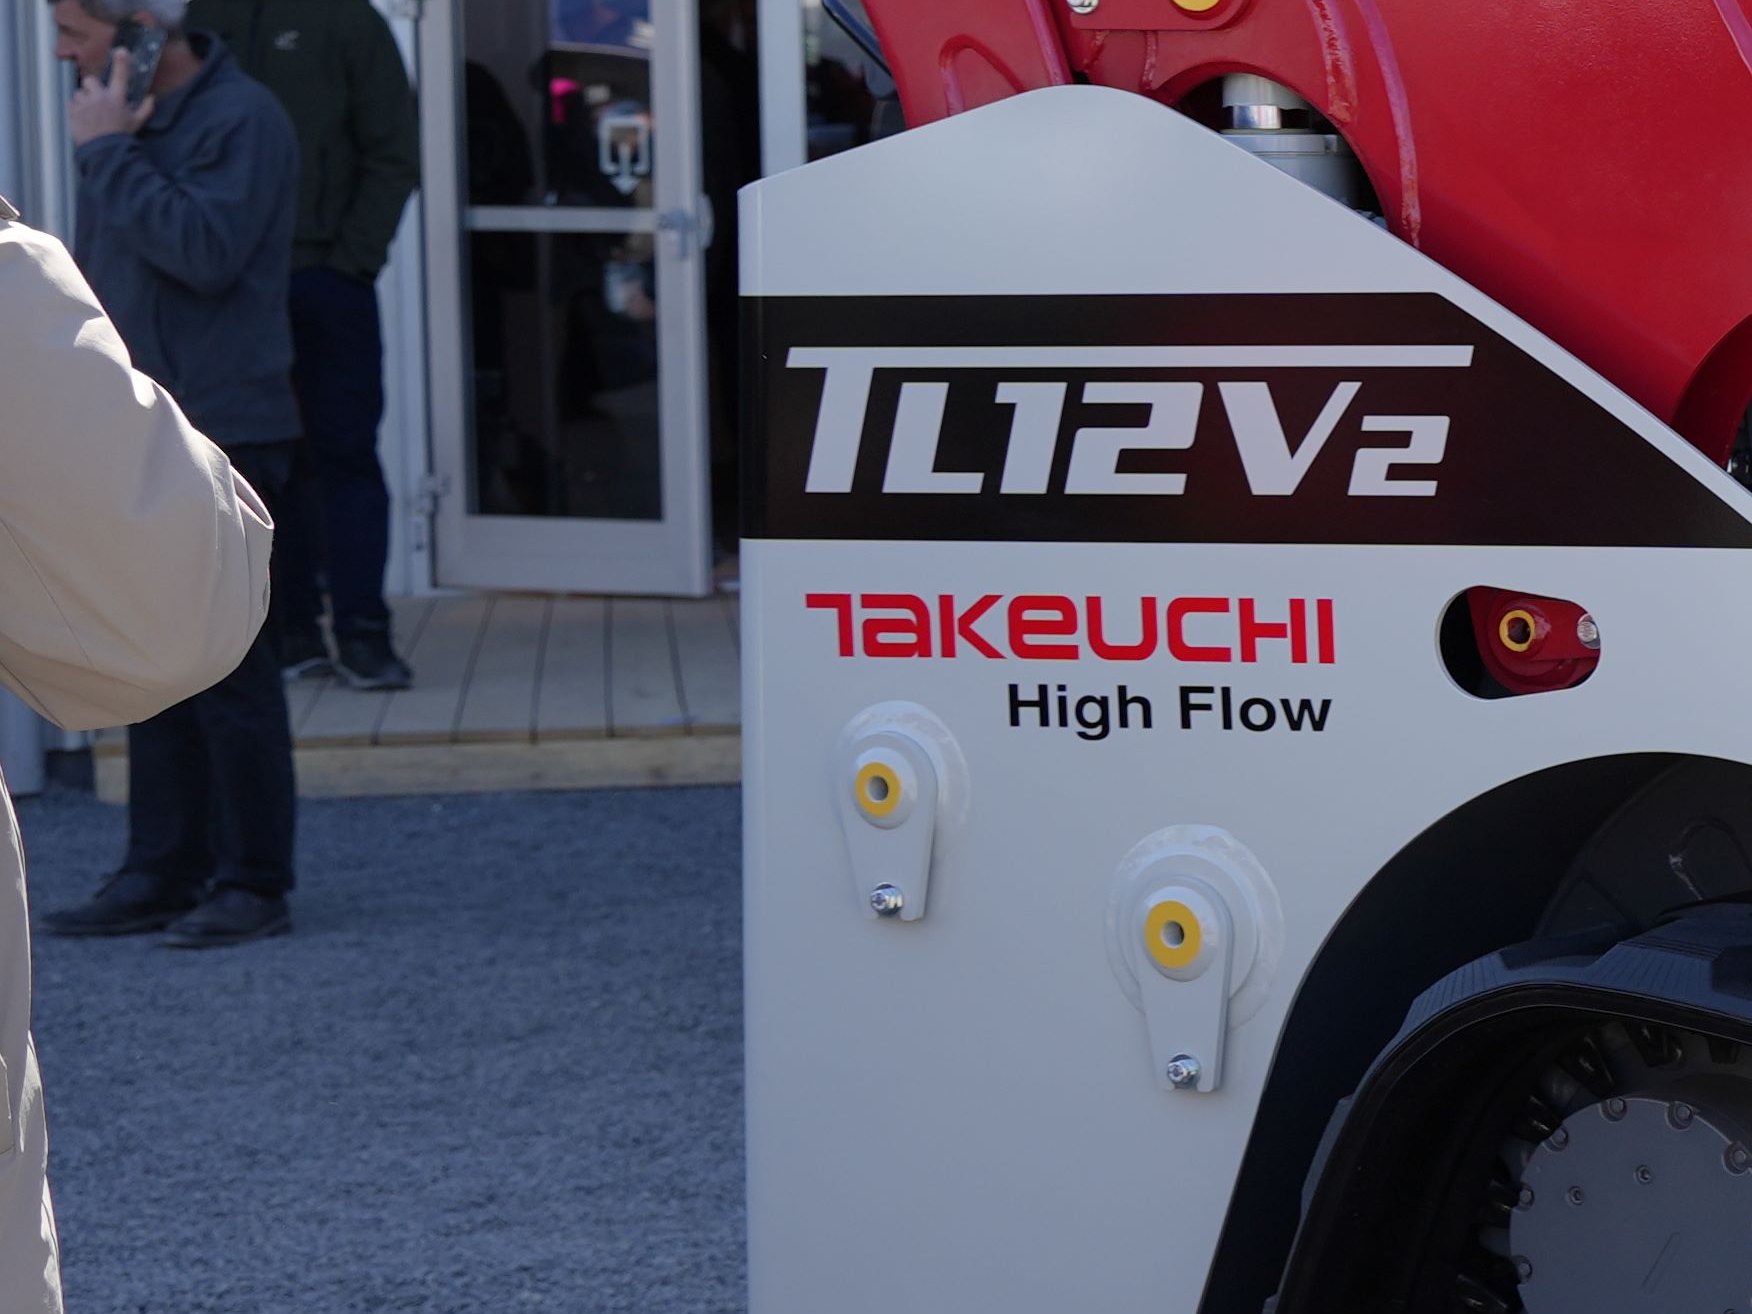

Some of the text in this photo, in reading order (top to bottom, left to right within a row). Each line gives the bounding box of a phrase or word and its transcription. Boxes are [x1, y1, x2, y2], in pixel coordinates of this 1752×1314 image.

[805, 592, 1336, 665] TAKEUCHI
[1008, 682, 1332, 740] High Flow
